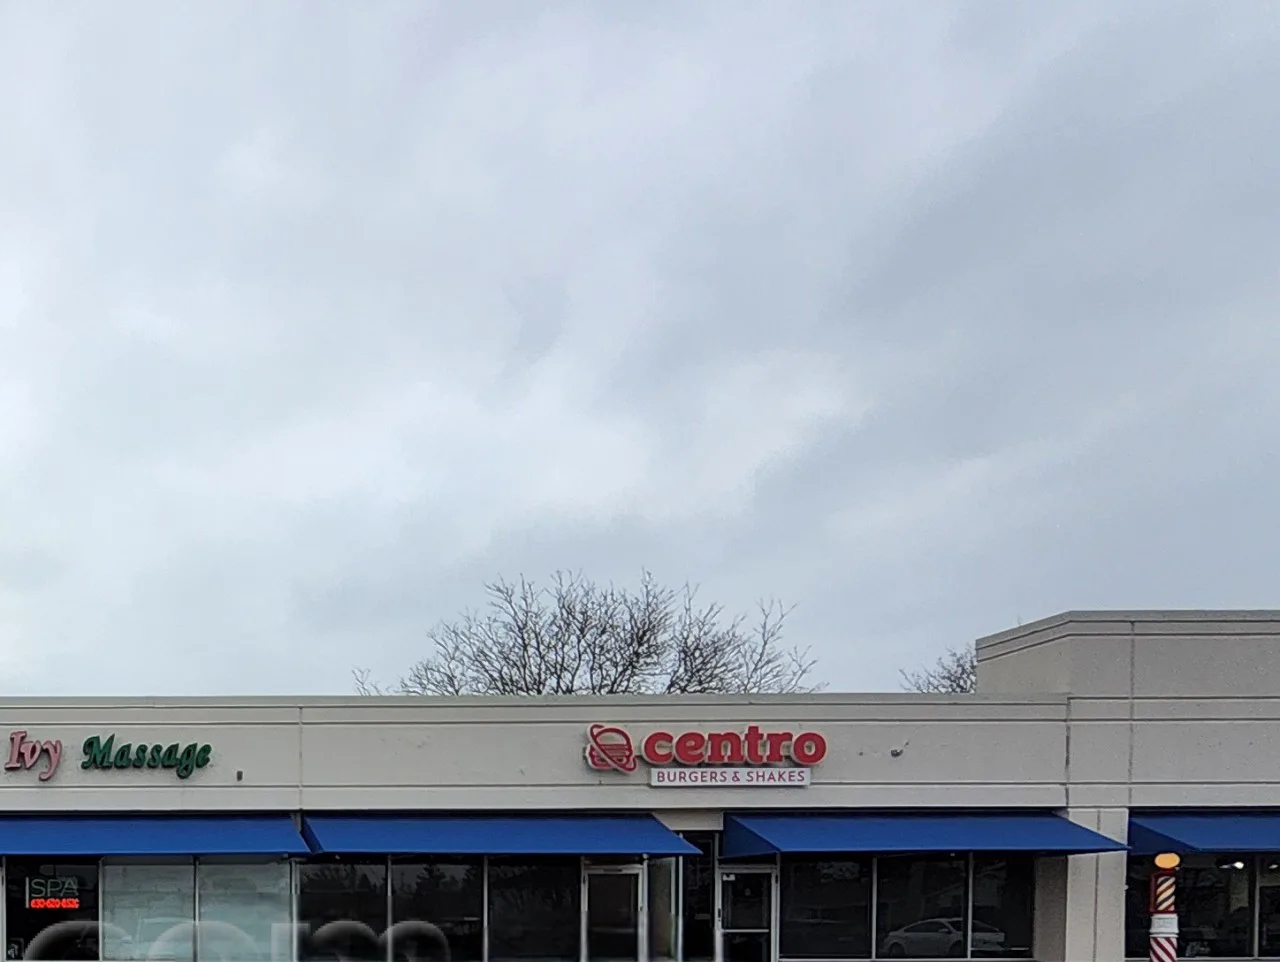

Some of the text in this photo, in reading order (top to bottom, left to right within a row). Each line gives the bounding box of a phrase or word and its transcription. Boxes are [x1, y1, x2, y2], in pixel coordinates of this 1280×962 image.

[4, 731, 212, 781] Ivy Massage
[642, 725, 827, 765] centro
[657, 770, 806, 783] BURGERS & SHAKES
[31, 878, 79, 897] SPA
